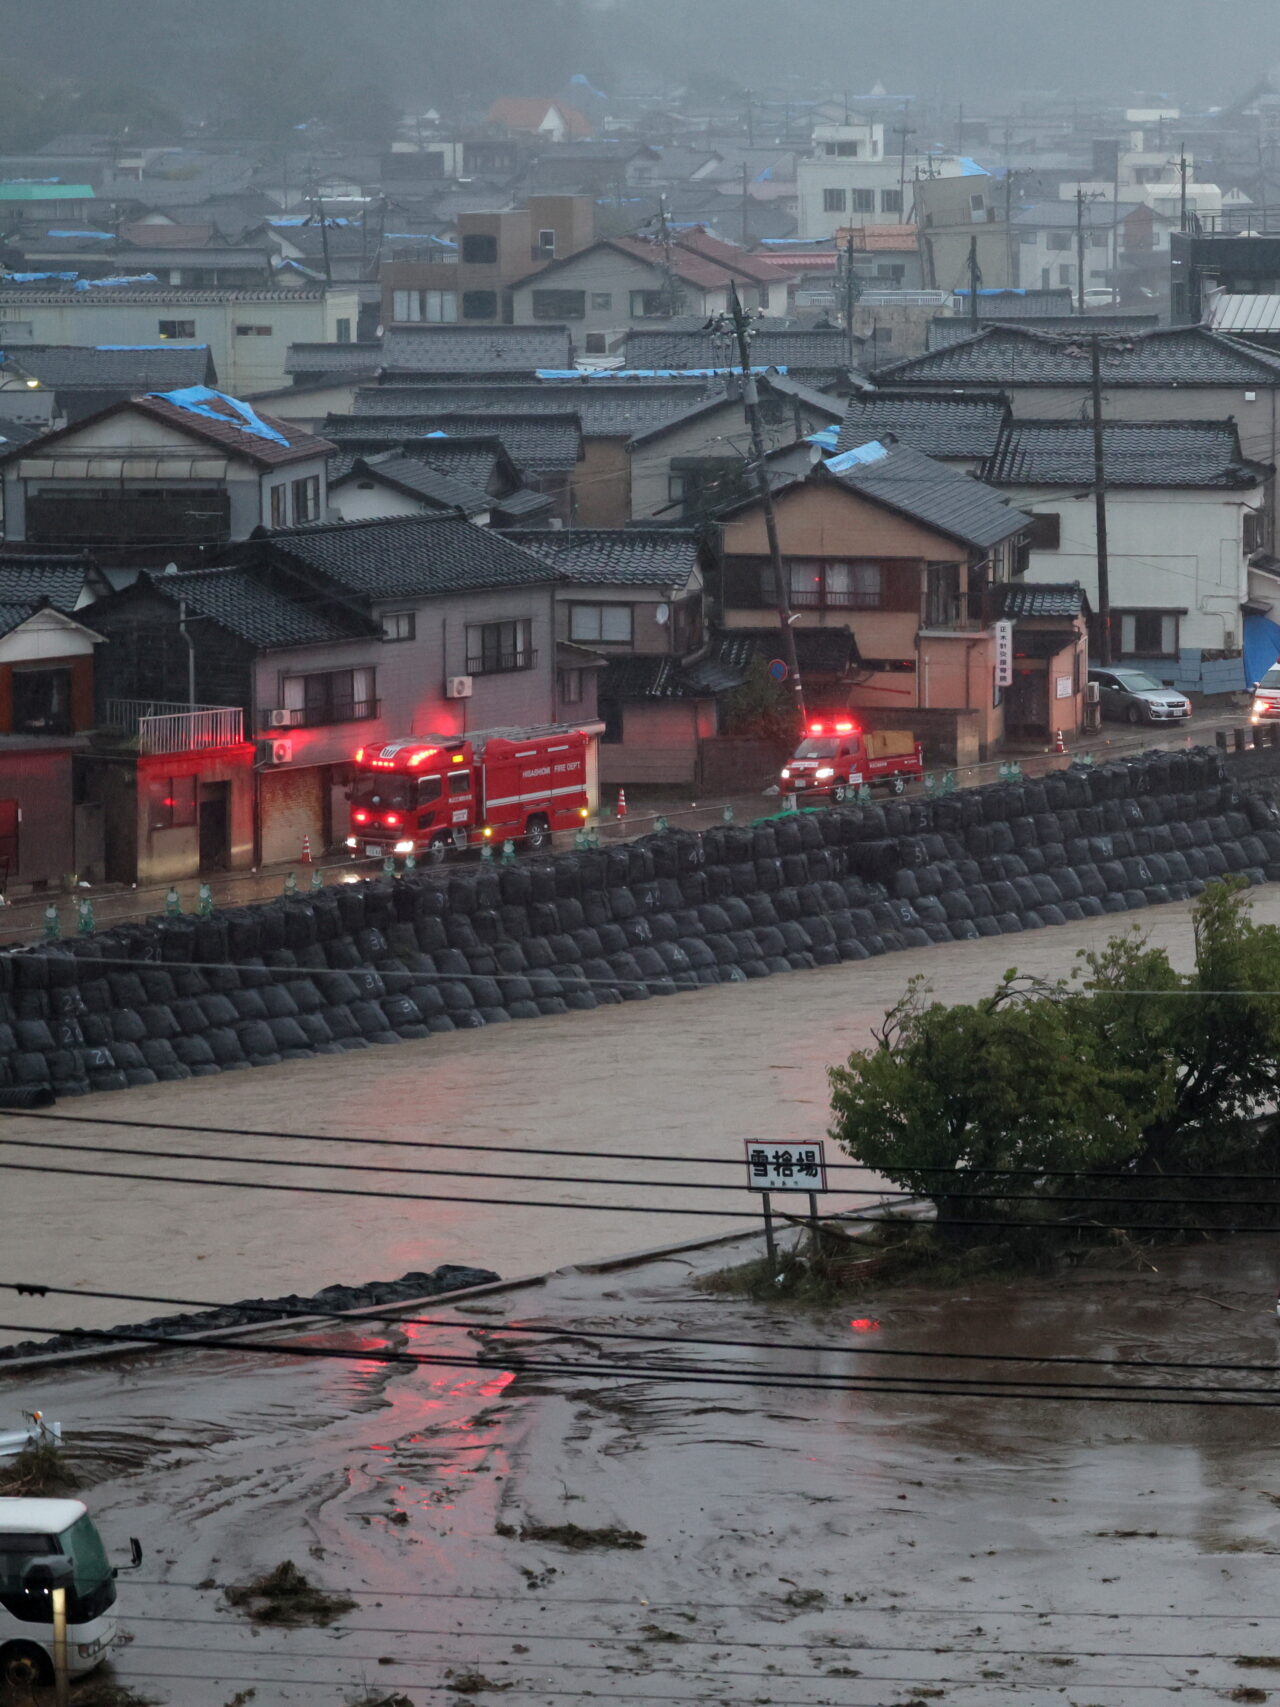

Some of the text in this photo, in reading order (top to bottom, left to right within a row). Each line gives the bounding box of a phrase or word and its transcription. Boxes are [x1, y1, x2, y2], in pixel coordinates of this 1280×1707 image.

[554, 764, 566, 773] FIRE
[751, 1150, 818, 1178] 雪捨場
